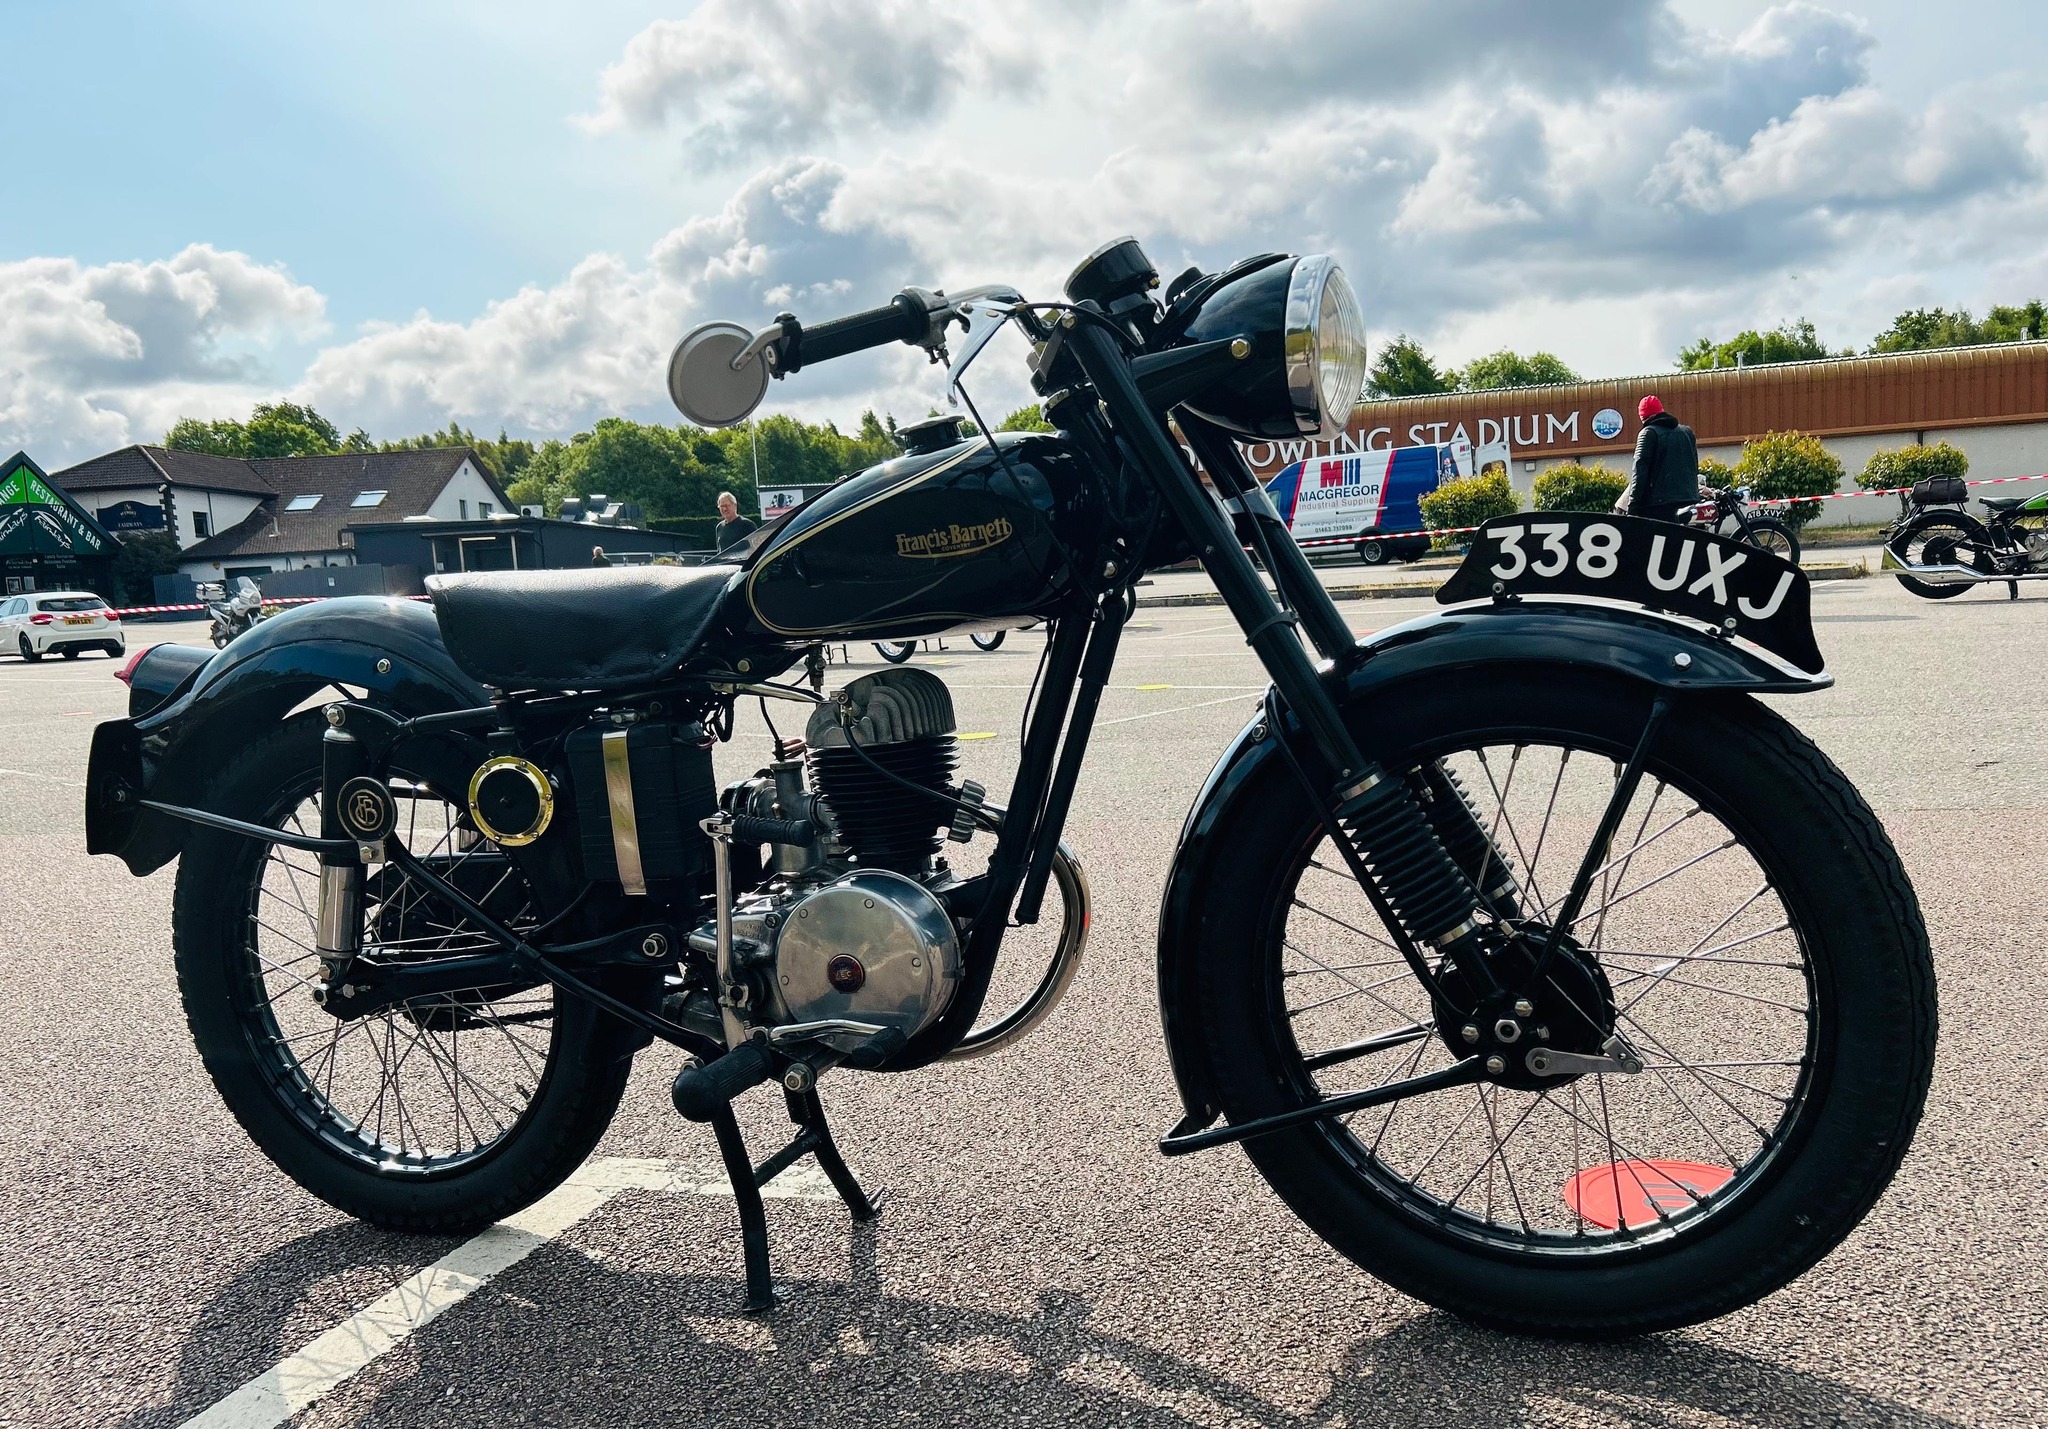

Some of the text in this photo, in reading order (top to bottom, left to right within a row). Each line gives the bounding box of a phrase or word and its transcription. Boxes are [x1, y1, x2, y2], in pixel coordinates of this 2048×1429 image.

[1232, 427, 1392, 467] OWING
[1408, 411, 1580, 447] STADIUM
[1298, 496, 1380, 511] Industrial Supplies
[1299, 484, 1379, 502] MACGREGOR
[30, 479, 101, 551] RESTAURANT & BAR
[941, 542, 971, 552] COVENTRY
[1486, 522, 1795, 620] 338 UXJ
